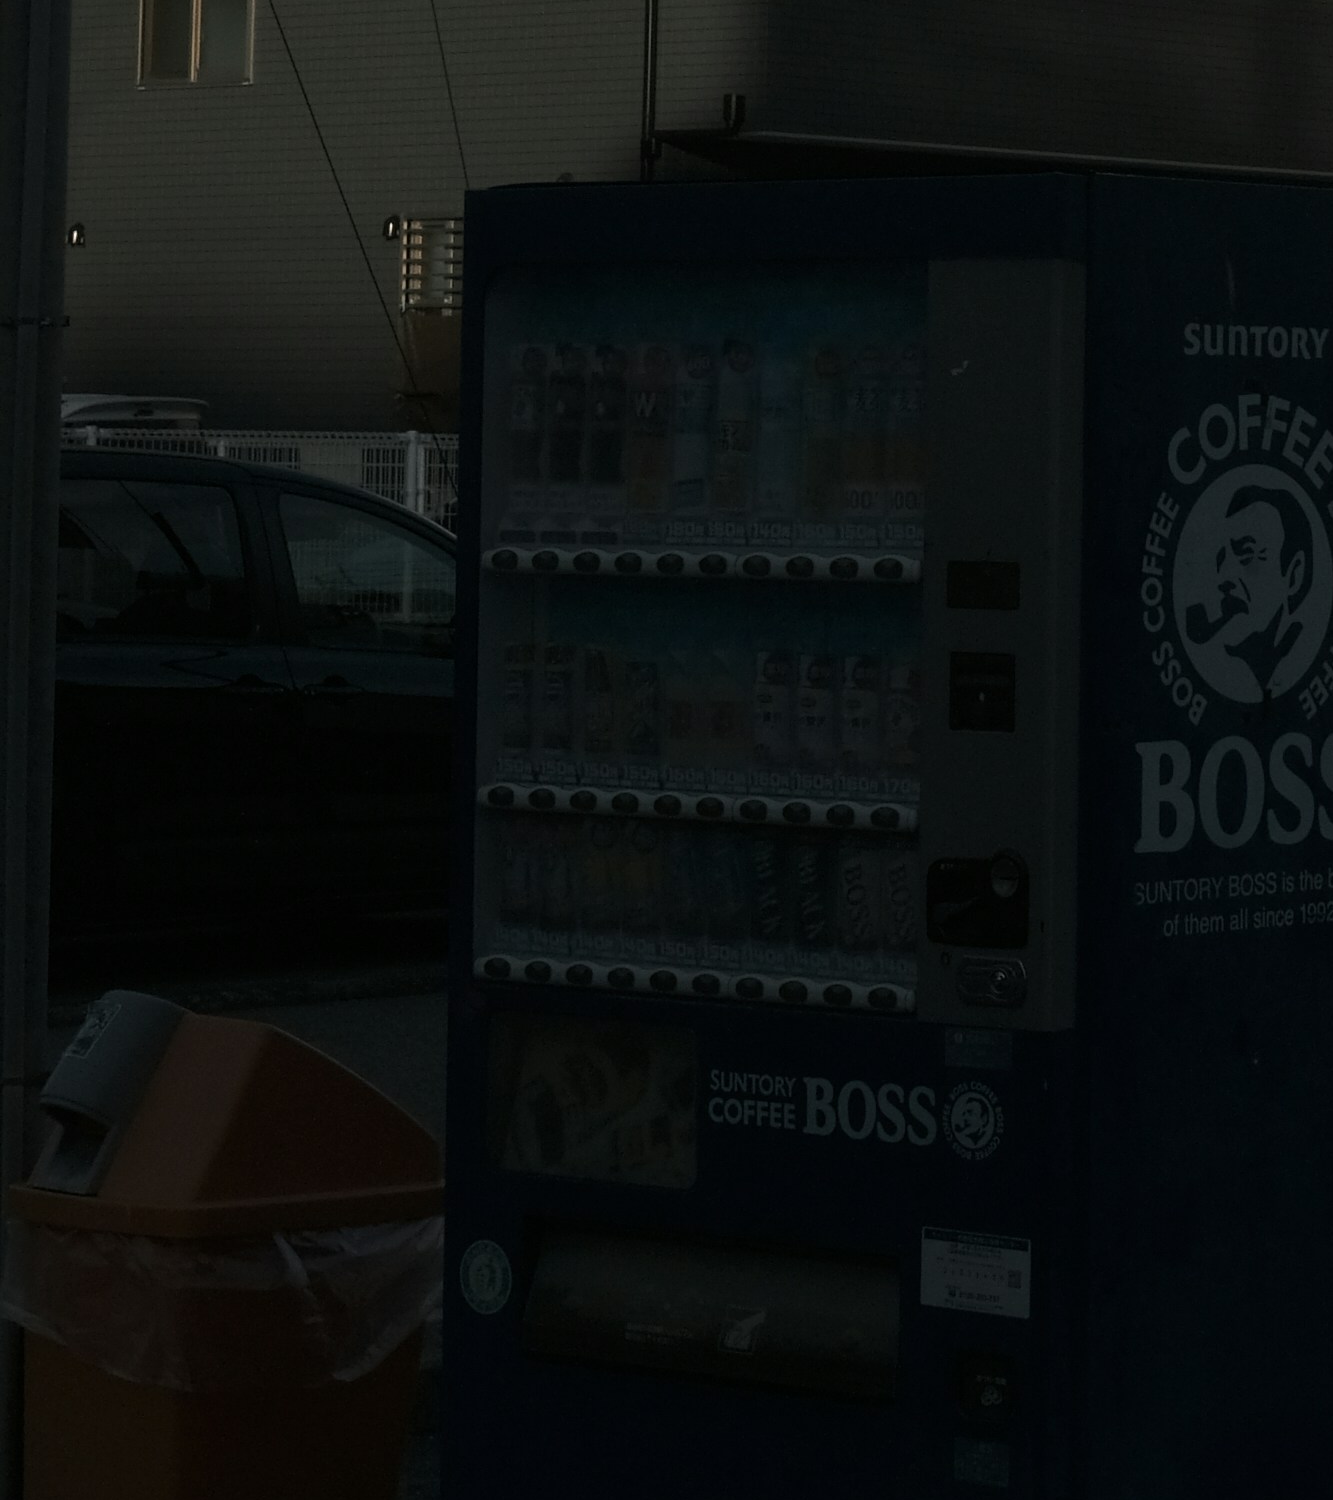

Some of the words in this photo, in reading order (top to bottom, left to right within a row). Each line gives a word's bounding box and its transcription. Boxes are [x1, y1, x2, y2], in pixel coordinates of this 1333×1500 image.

[1140, 491, 1181, 634] COFFEE
[1151, 640, 1208, 727] BOSS
[1133, 876, 1223, 906] SUNTORY
[1228, 871, 1277, 898] BOSS
[1281, 872, 1295, 892] is
[1300, 868, 1324, 892] the
[1163, 913, 1180, 938] of
[1184, 912, 1225, 936] them
[1229, 907, 1249, 931] all
[1253, 906, 1294, 930] since
[707, 1097, 796, 1130] COFFEE
[709, 1069, 797, 1098] SUNTORY
[802, 1076, 937, 1146] BOSS
